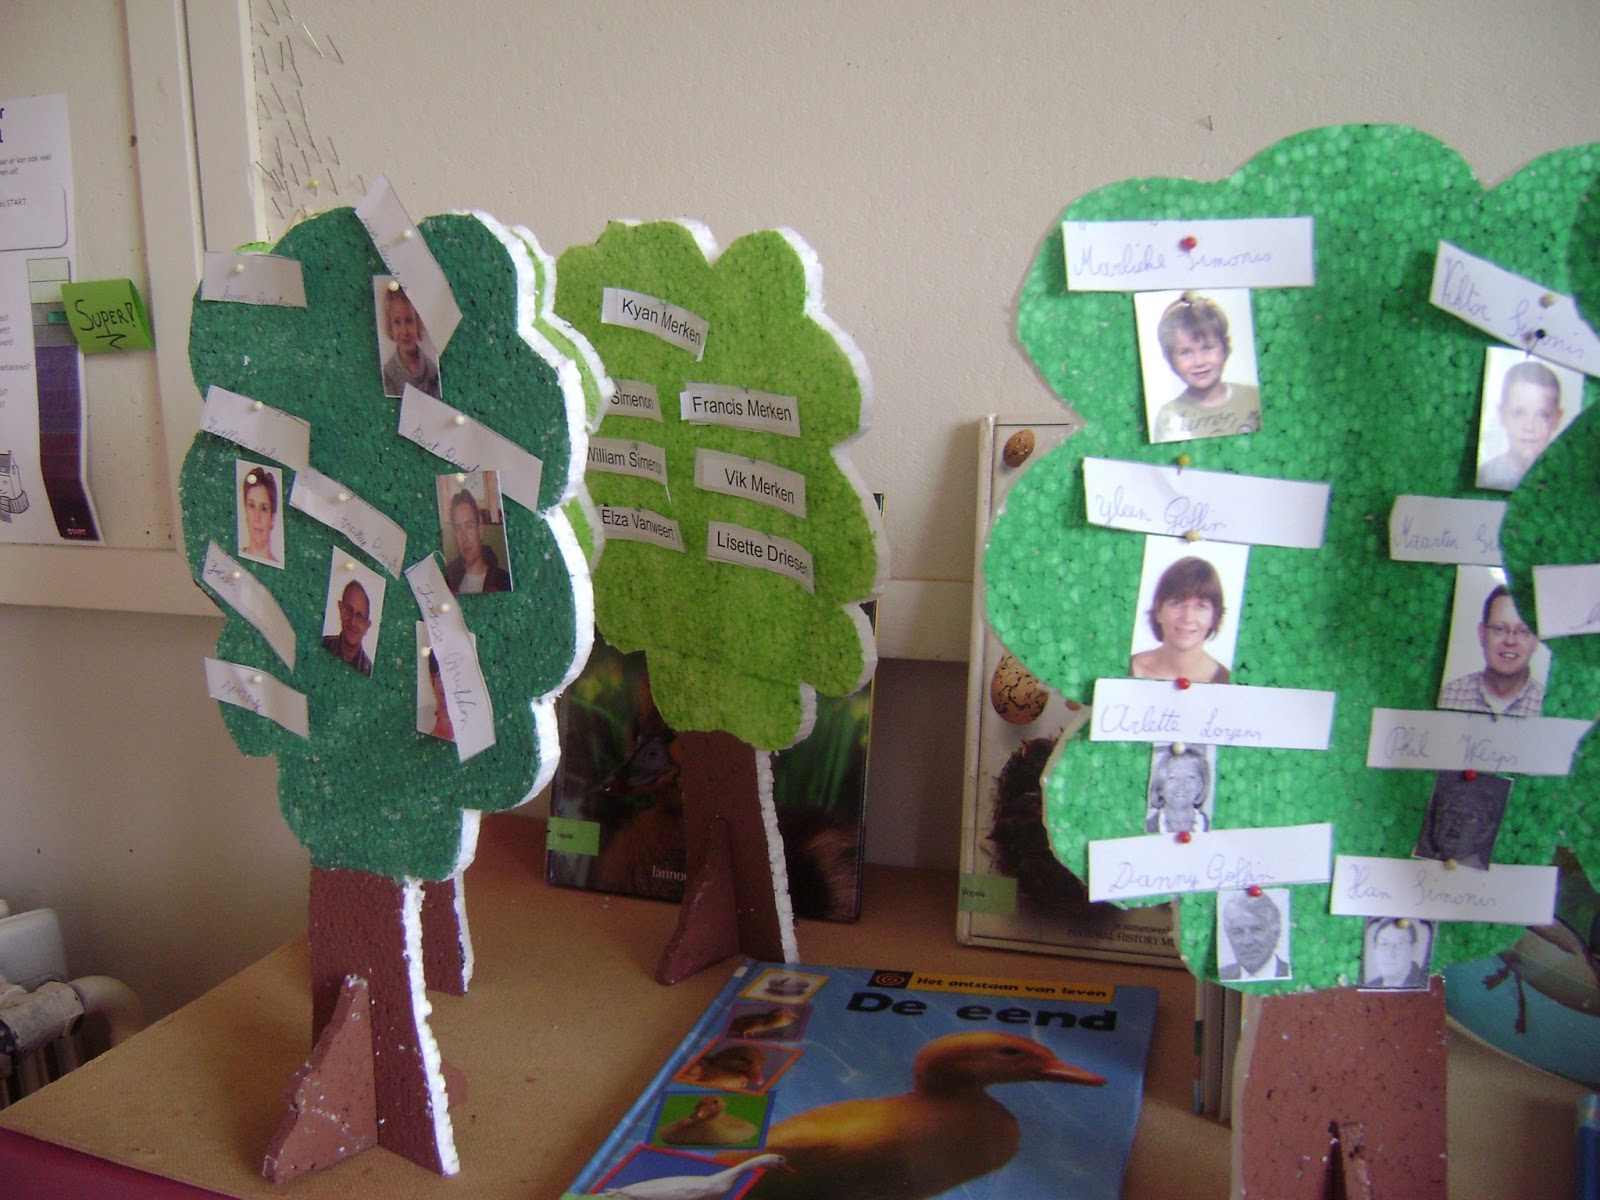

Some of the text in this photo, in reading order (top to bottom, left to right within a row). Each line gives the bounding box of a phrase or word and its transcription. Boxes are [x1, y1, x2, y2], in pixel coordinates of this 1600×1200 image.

[622, 298, 701, 346] Kyan Merken
[692, 396, 792, 422] Francis Merken
[724, 468, 795, 505] Vik Merken
[602, 509, 629, 527] Elza
[717, 530, 763, 558] Lisette
[1109, 860, 1199, 893] Danny
[1117, 932, 1159, 945] HISTORY
[917, 976, 1107, 999] Het ontstaan van leven
[846, 991, 1119, 1032] De eend
